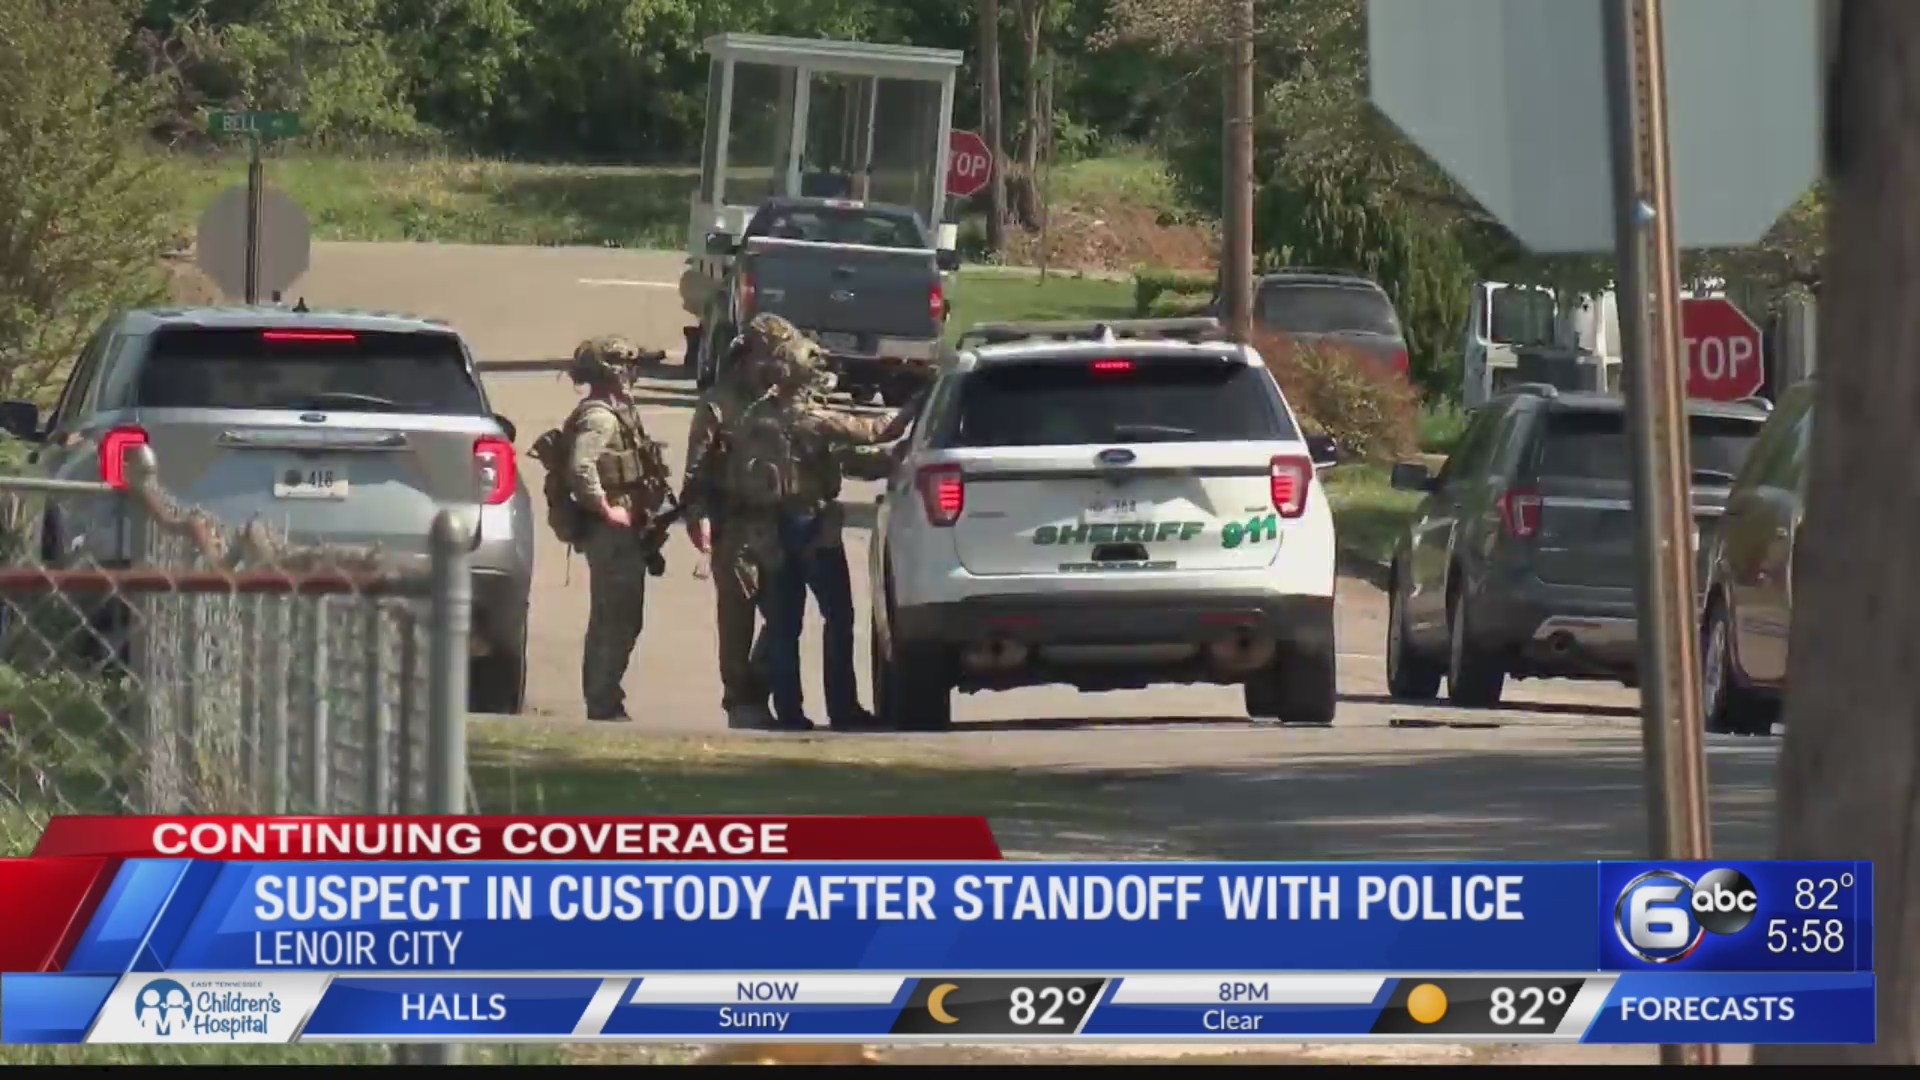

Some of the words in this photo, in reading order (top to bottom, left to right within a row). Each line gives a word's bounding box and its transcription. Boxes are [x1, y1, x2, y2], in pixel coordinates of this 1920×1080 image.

[223, 114, 260, 132] BELL
[948, 150, 986, 178] TOP
[1682, 336, 1753, 382] TOP
[1033, 520, 1205, 546] SHERIFF
[1221, 513, 1277, 548] 911
